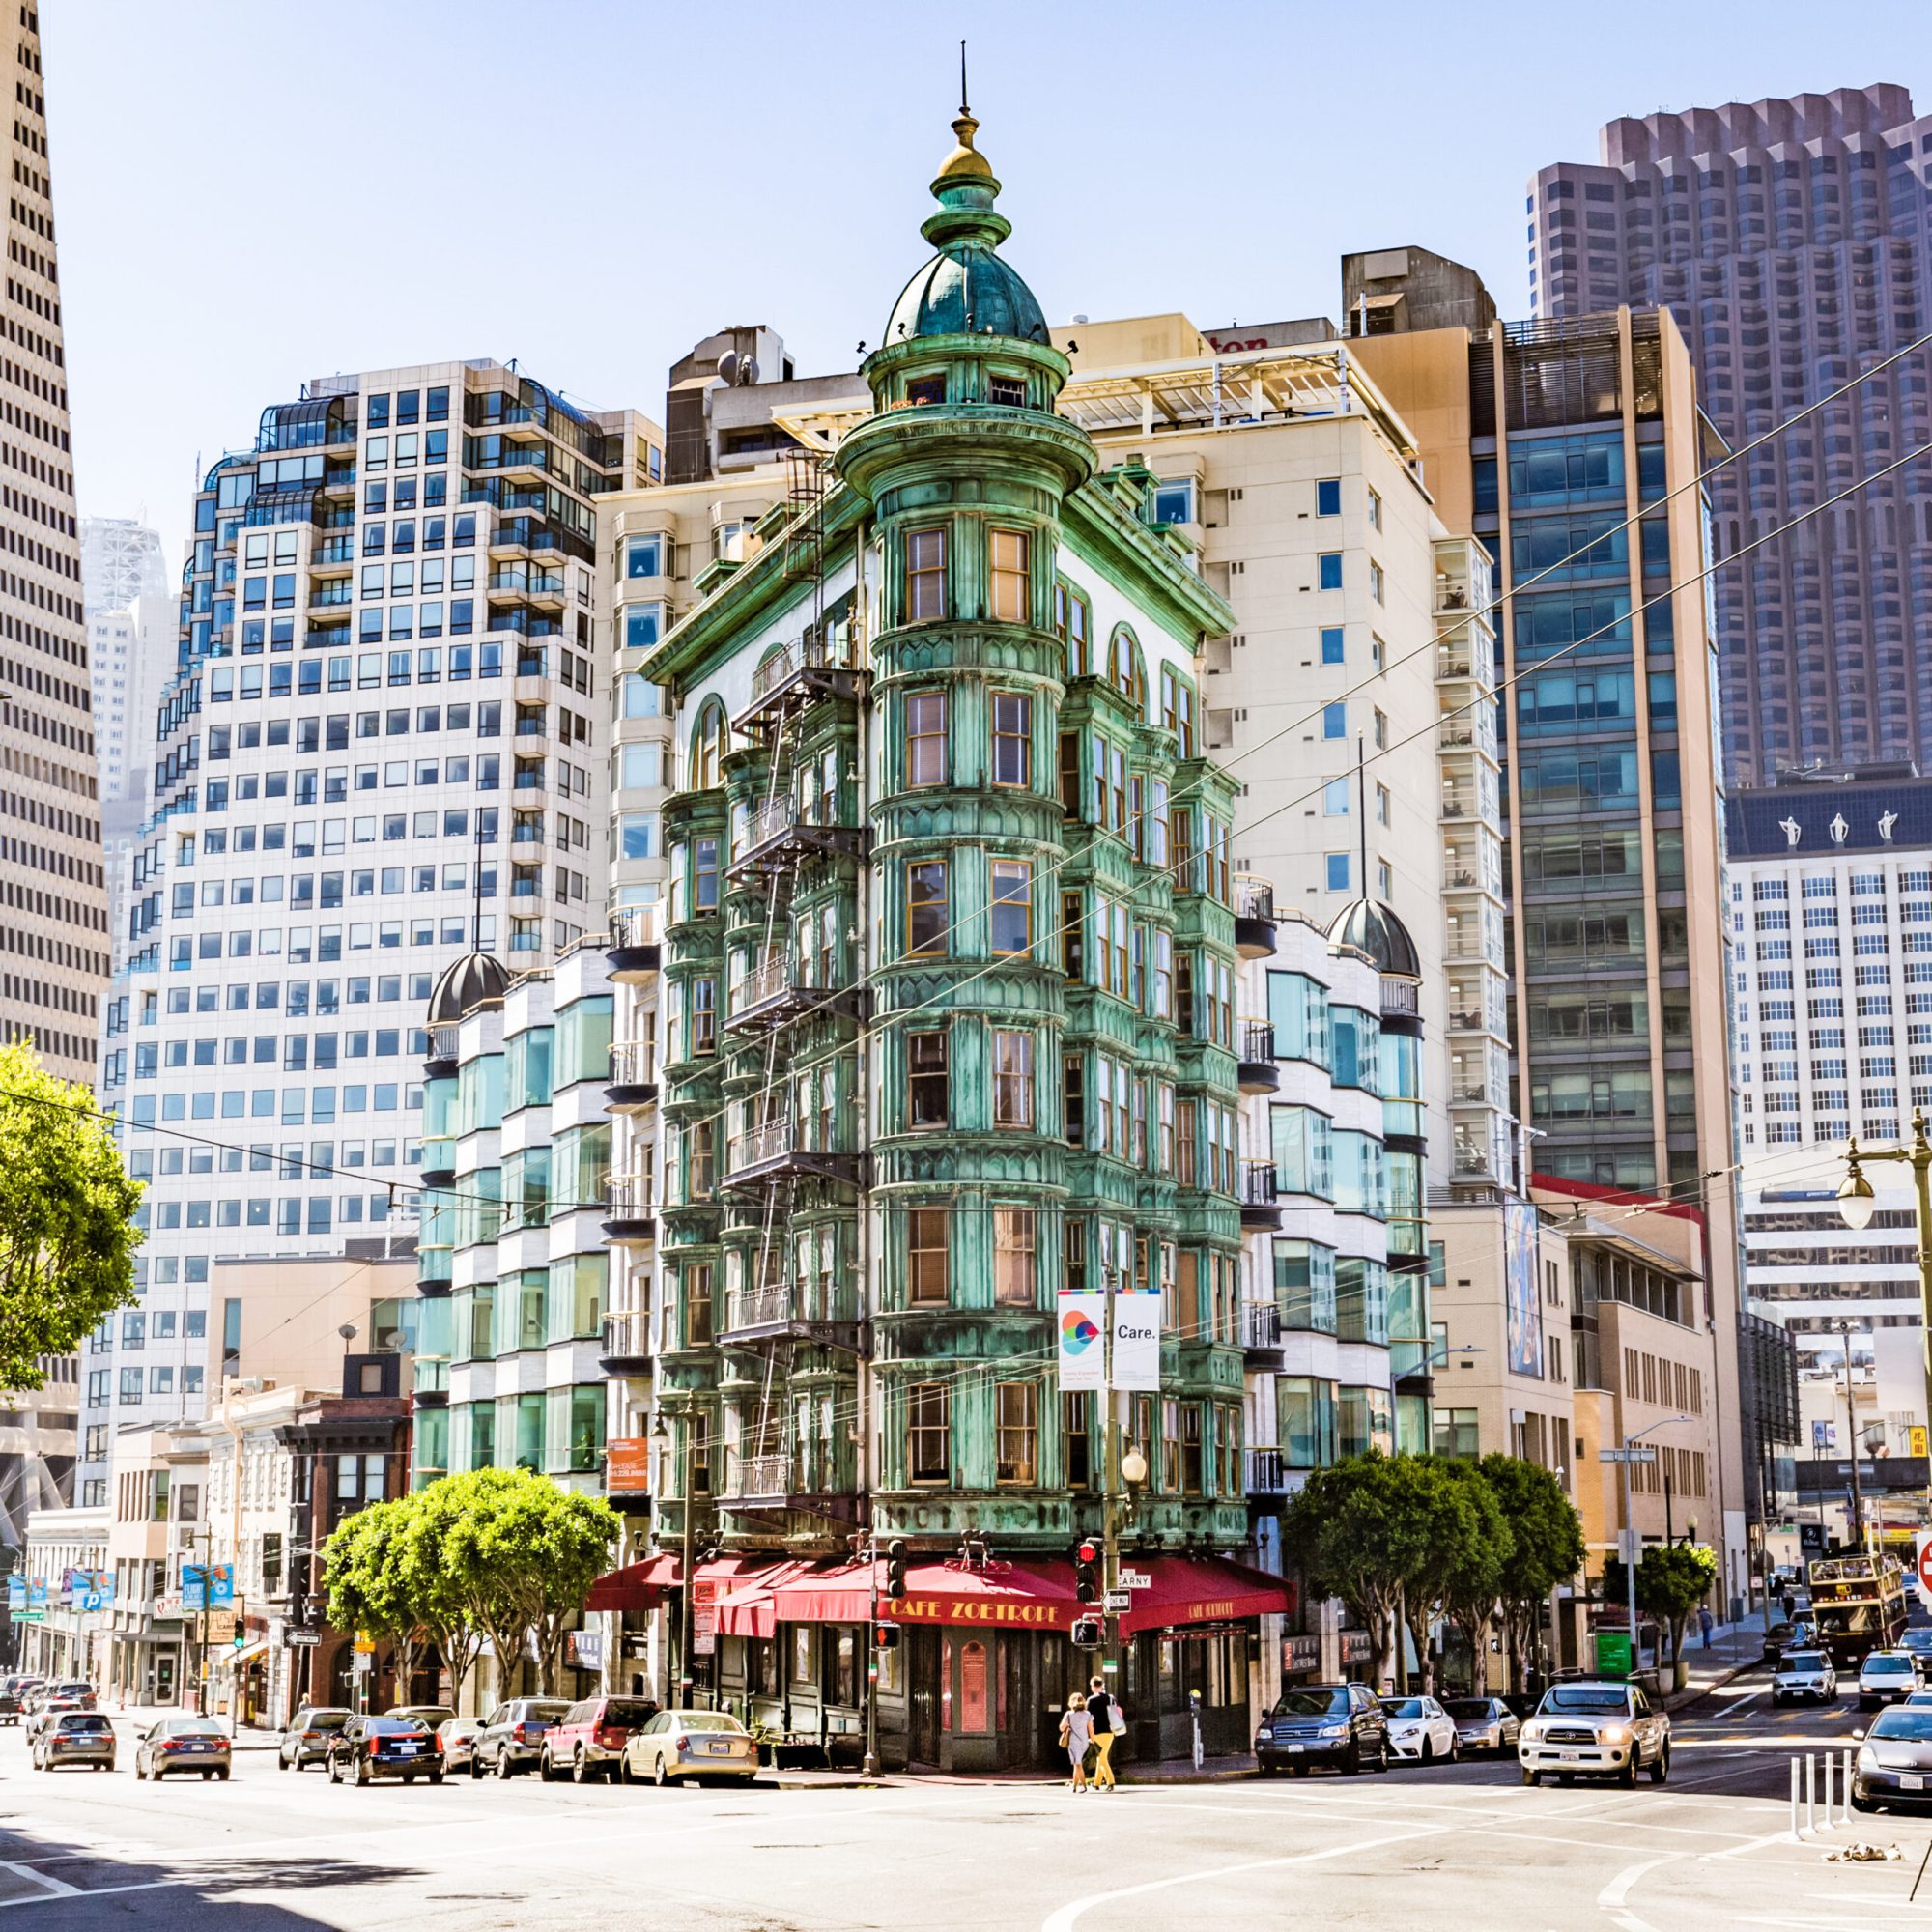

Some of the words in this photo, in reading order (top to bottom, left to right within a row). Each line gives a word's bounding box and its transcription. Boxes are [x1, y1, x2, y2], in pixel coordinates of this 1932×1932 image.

[1118, 1325, 1156, 1339] Care.
[1110, 1597, 1119, 1605] ONE
[1119, 1596, 1127, 1605] WAY
[890, 1599, 942, 1618] CAFE
[951, 1602, 1059, 1623] ZOETROPE
